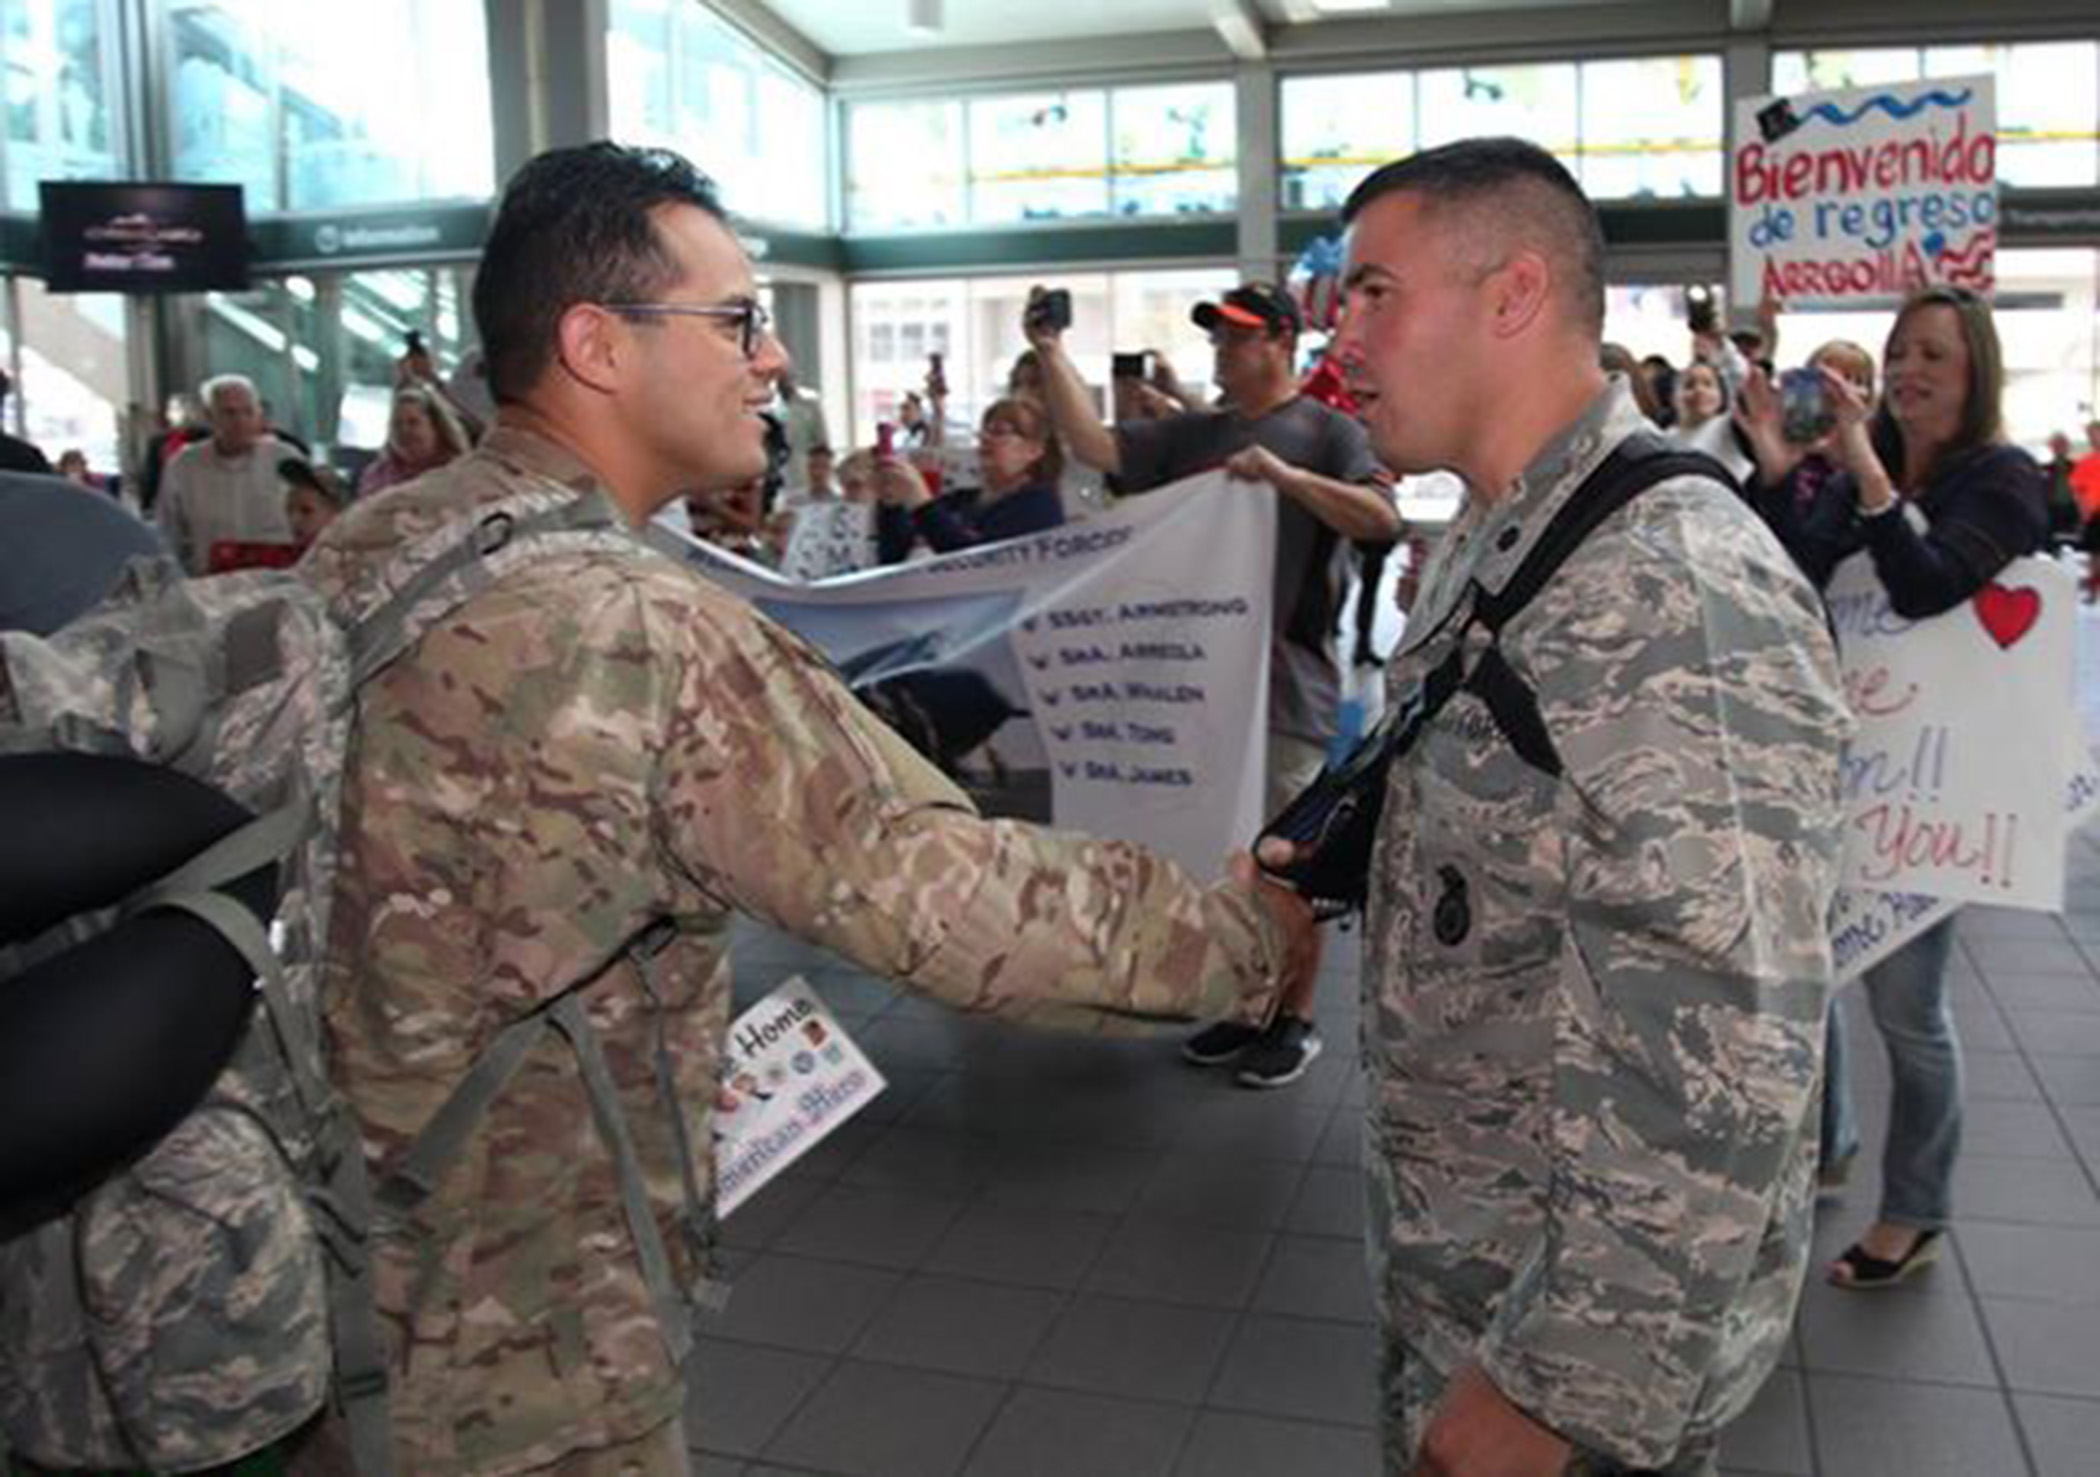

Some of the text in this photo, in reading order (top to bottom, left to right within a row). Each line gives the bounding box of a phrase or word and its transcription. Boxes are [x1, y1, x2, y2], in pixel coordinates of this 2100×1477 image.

[1736, 111, 1995, 206] Bienvenido
[1750, 192, 1995, 247] de regreso
[1118, 597, 1249, 622] ARMSTRONG
[1855, 804, 2018, 890] You!!
[734, 998, 813, 1055] Home
